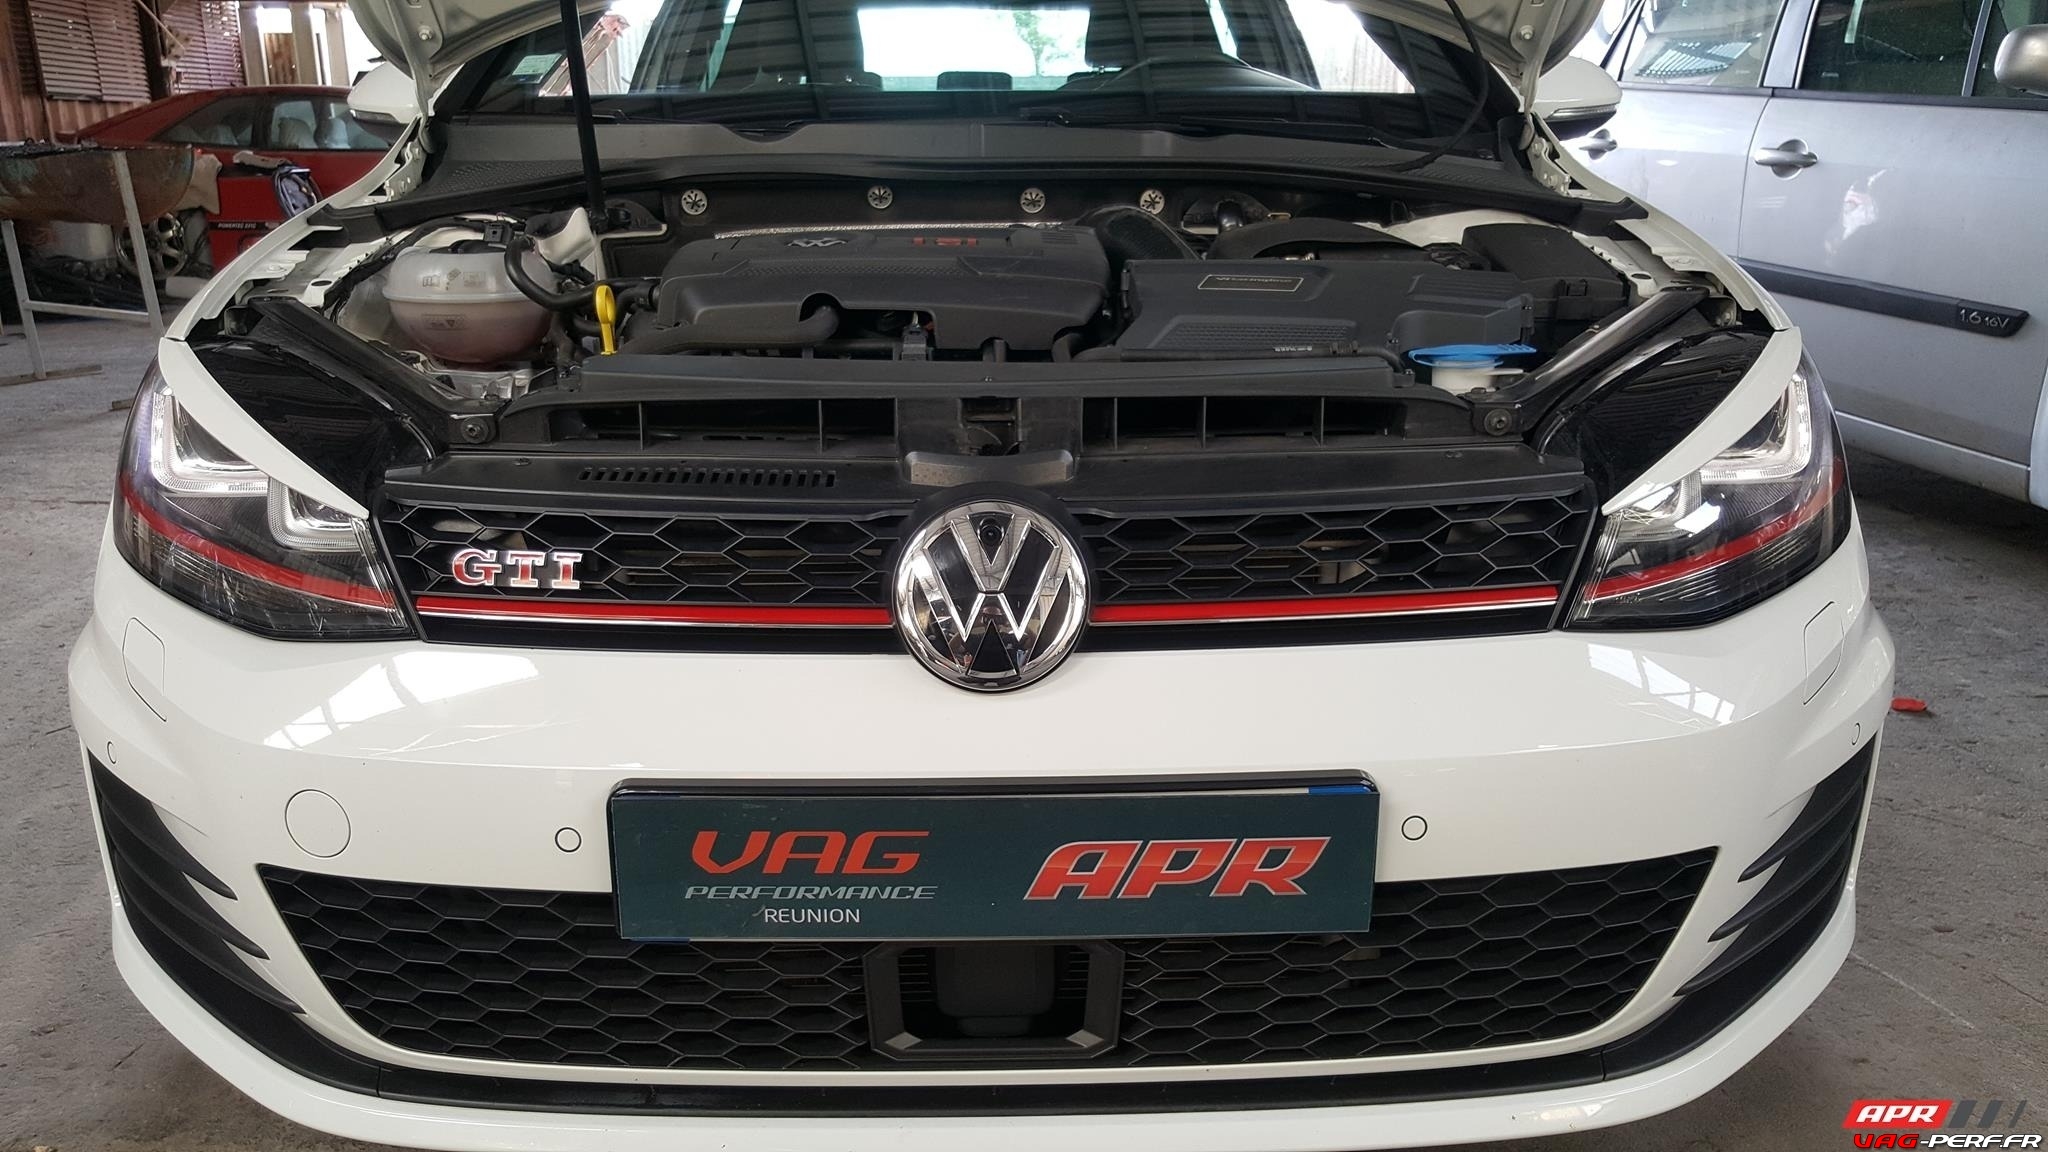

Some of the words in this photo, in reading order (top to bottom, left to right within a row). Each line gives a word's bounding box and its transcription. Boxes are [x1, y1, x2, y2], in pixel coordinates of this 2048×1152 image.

[1960, 308, 1982, 324] 1.6
[1984, 316, 2010, 329] 16V
[452, 548, 584, 590] GTI
[691, 831, 929, 874] VAG
[1023, 836, 1332, 900] APR
[685, 885, 938, 900] PERFORMANCE
[764, 908, 860, 923] REUNION
